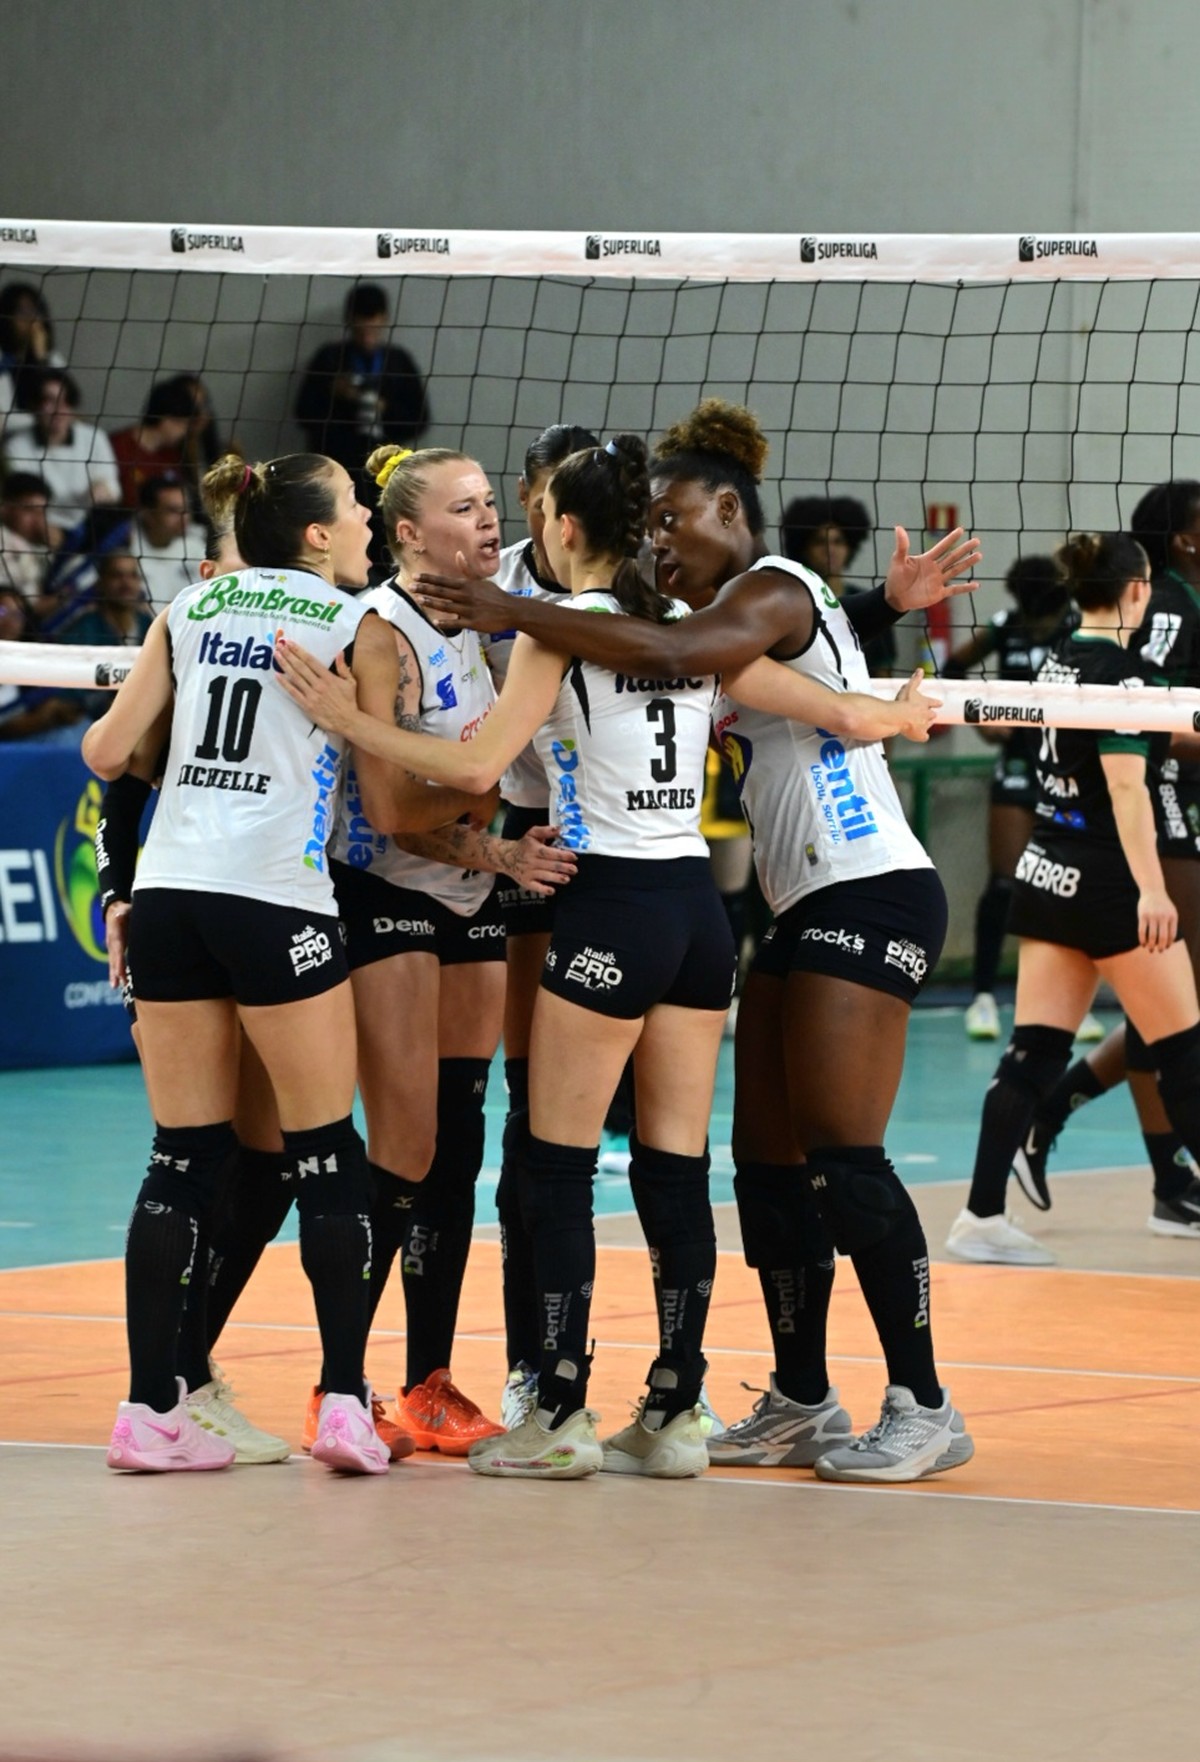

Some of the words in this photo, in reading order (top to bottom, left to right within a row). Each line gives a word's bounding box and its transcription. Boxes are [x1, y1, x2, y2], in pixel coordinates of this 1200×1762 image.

[0, 228, 38, 245] ERLIGA
[187, 233, 245, 253] SUPERLIGA
[393, 236, 450, 256] SUPERLIGA
[603, 239, 661, 257] SUPERLIGA
[817, 241, 878, 260] SUPERLIGA
[1036, 239, 1098, 258] SUPERLIGA
[195, 675, 262, 763] 10
[982, 705, 1045, 724] SUPERLIGA
[646, 698, 676, 783] 3
[625, 788, 696, 811] MACRIS
[816, 727, 878, 841] entil
[1032, 858, 1081, 898] BRB
[0, 849, 58, 942] EI
[288, 932, 330, 965] PRO
[801, 928, 866, 951] crock's
[569, 953, 623, 986] PRO
[886, 940, 928, 976] PRO
[771, 1269, 795, 1333] Dentil
[912, 1257, 928, 1328] Dentil
[544, 1292, 563, 1350] Dentil
[662, 1289, 679, 1349] Dentil
